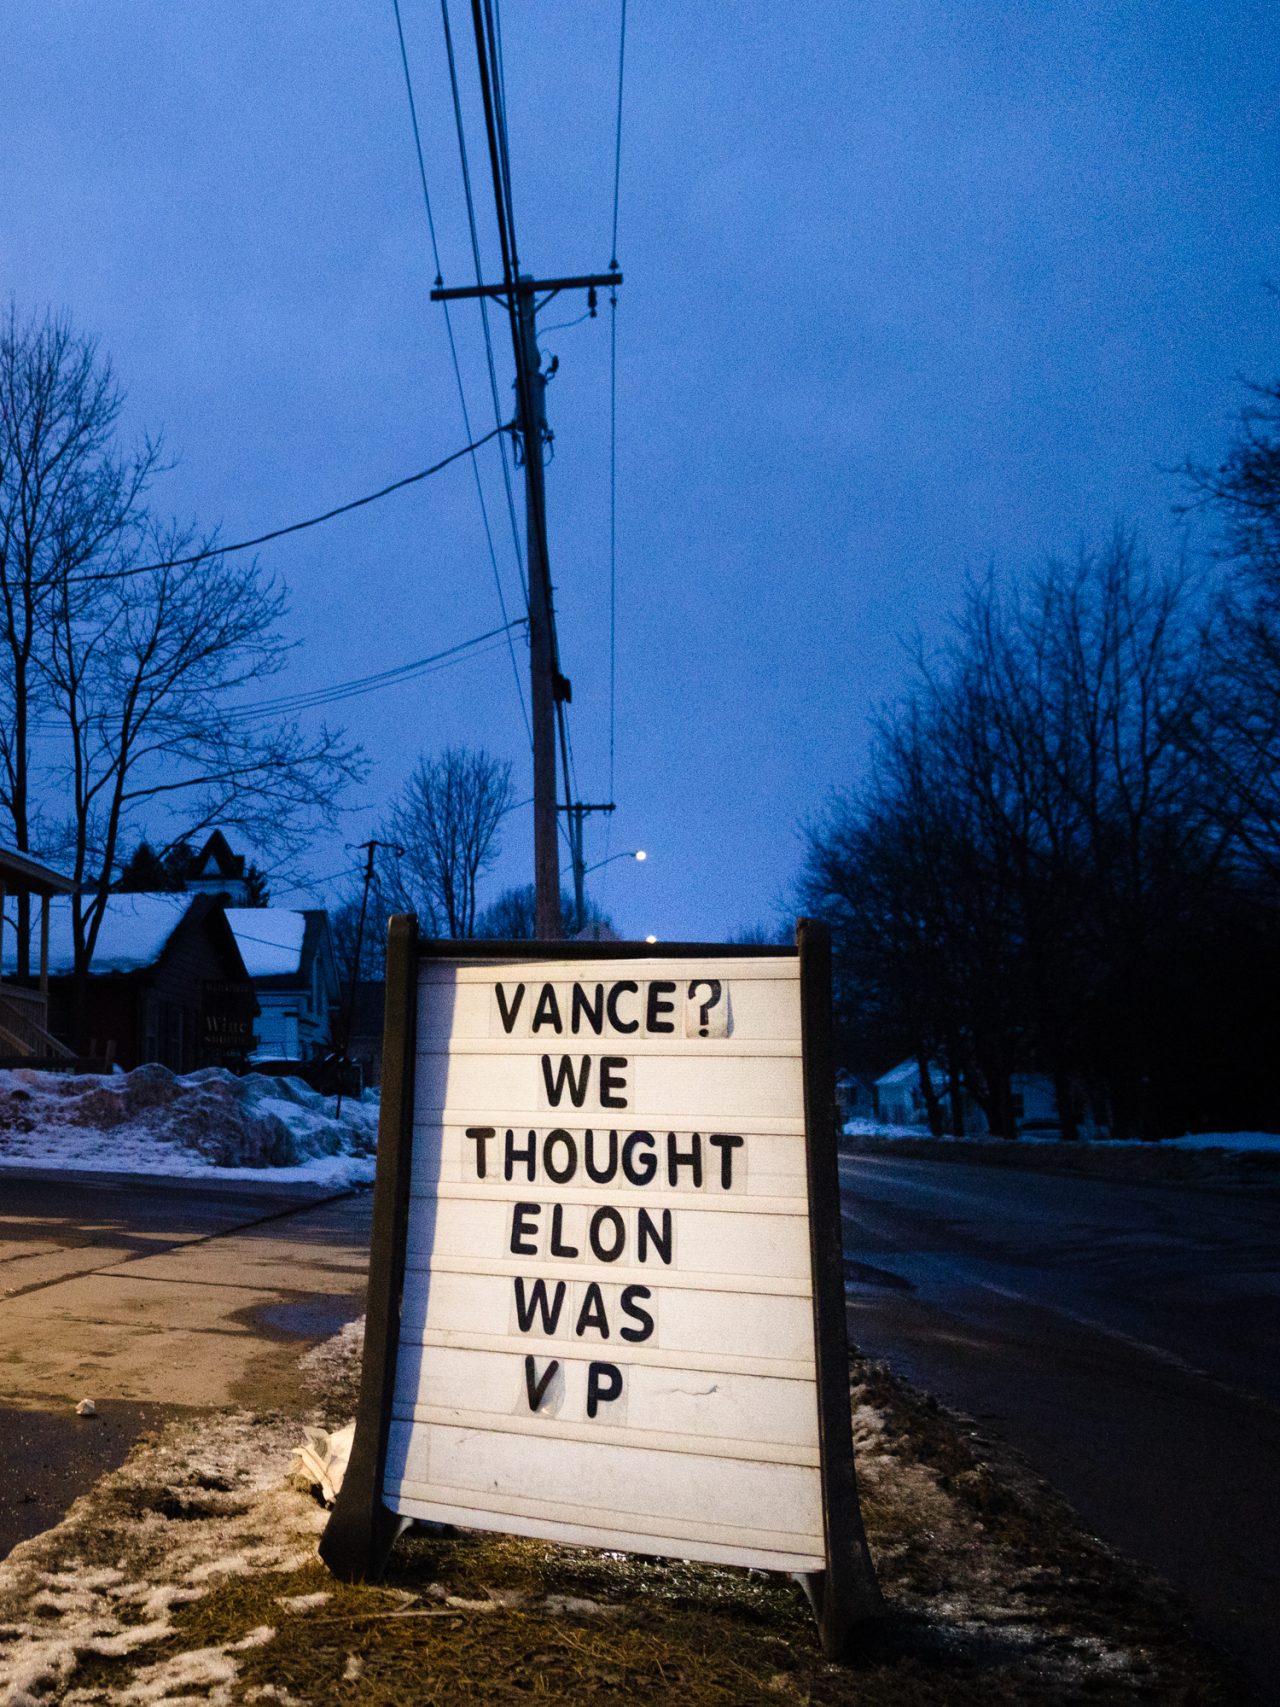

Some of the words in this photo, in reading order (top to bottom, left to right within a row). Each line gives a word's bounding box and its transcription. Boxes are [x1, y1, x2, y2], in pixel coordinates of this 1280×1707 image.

[496, 979, 721, 1038] VANCE?
[542, 1054, 628, 1109] WE
[466, 1127, 745, 1191] THOUGHT
[509, 1203, 673, 1265] ELON
[514, 1276, 655, 1343] WAS
